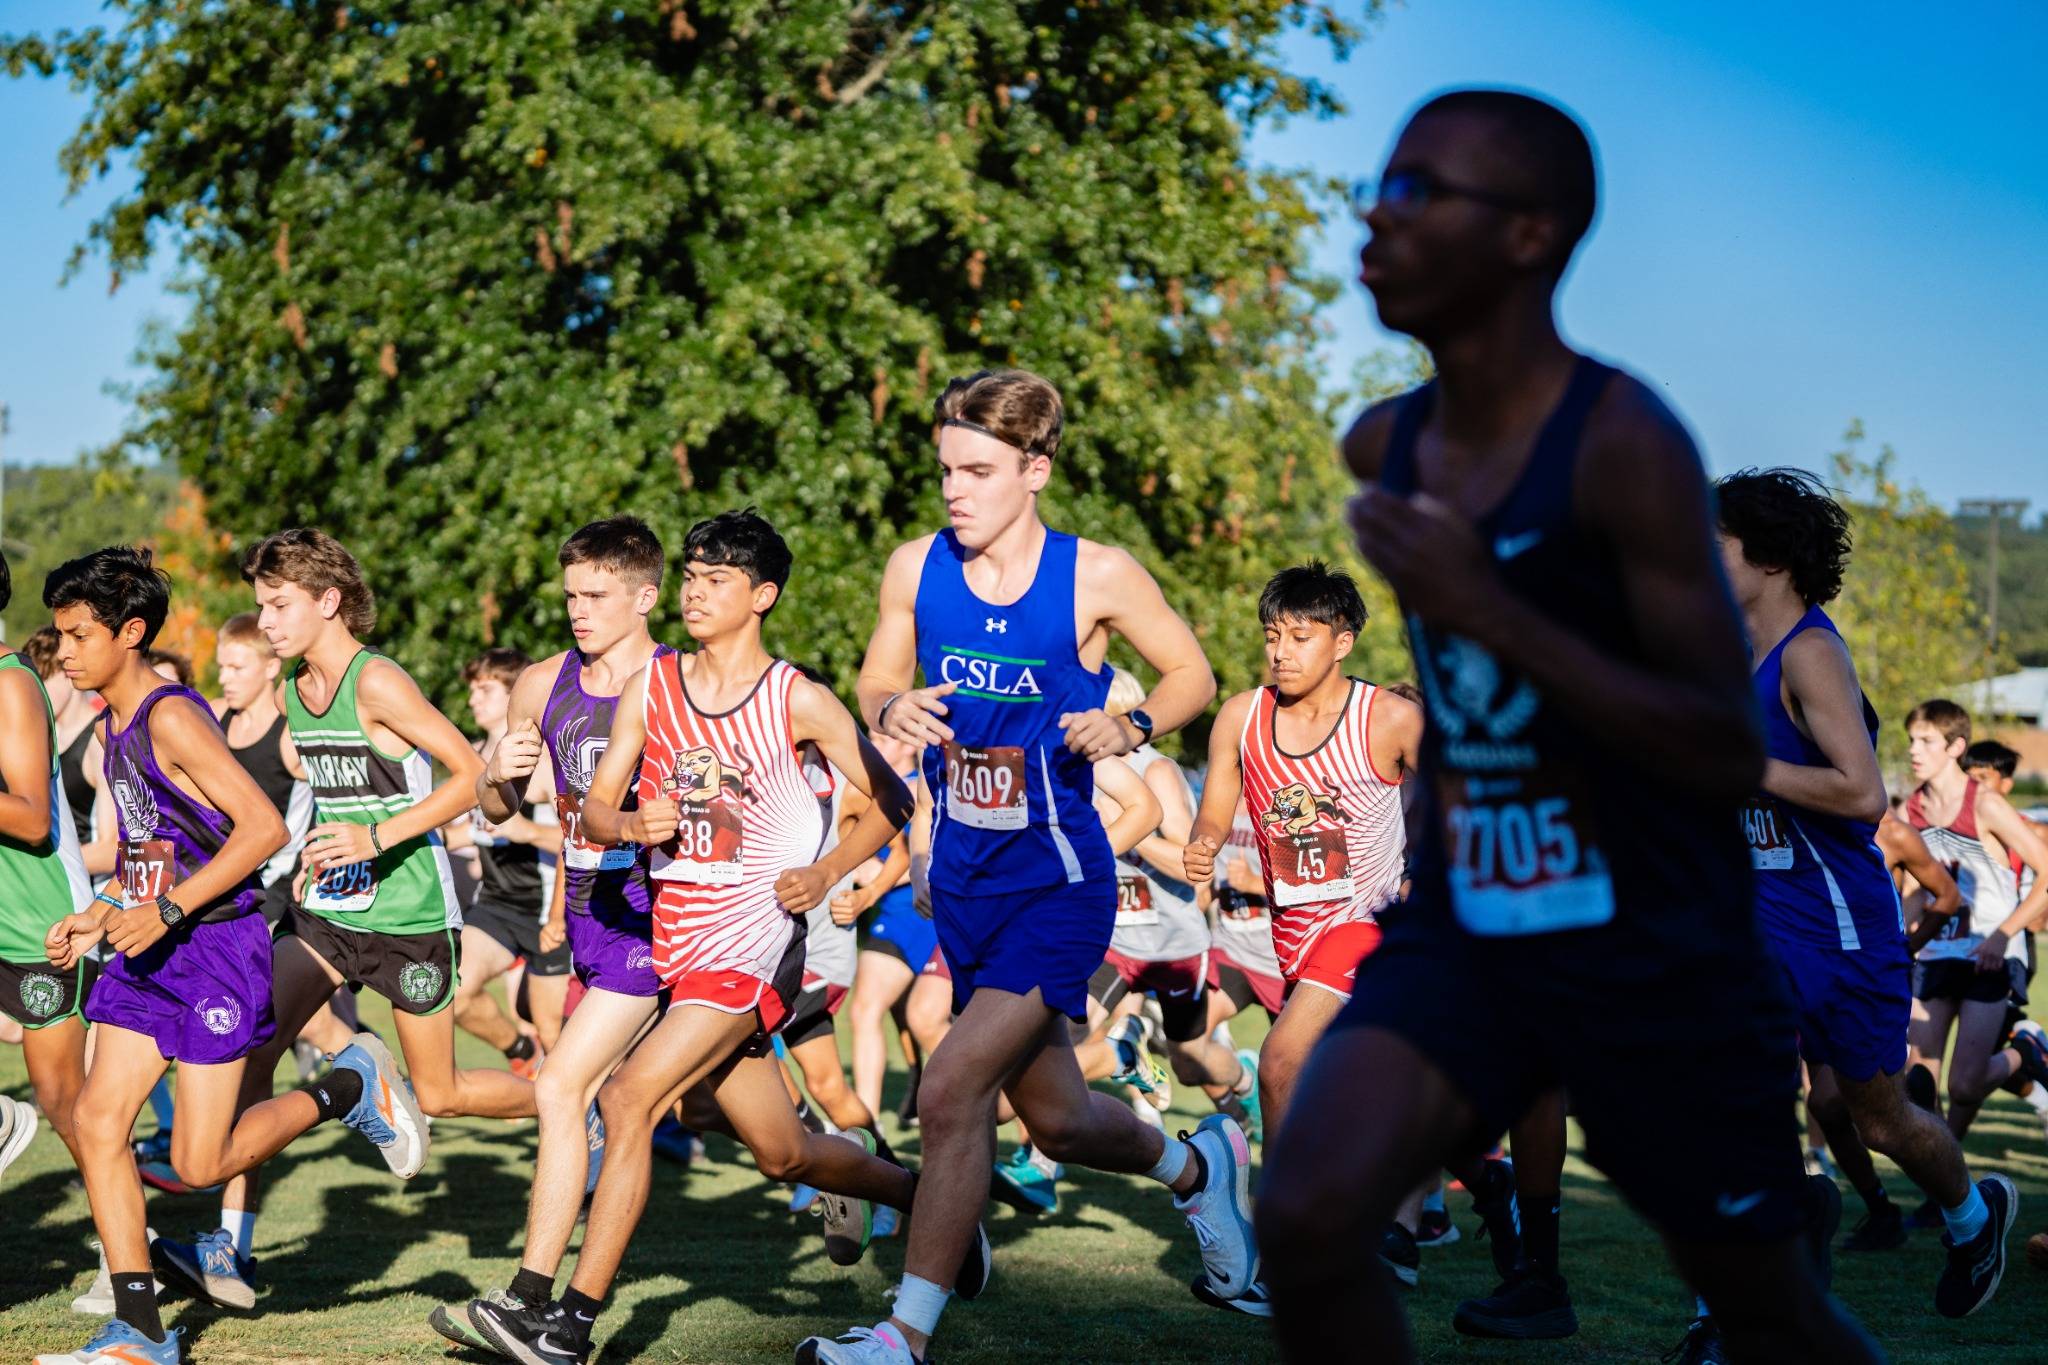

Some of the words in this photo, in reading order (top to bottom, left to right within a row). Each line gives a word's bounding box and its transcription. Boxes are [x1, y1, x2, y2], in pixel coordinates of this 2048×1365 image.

[941, 655, 1042, 695] CSLA
[950, 759, 1013, 804] 2609
[679, 819, 713, 858] 38
[1297, 848, 1325, 880] 45
